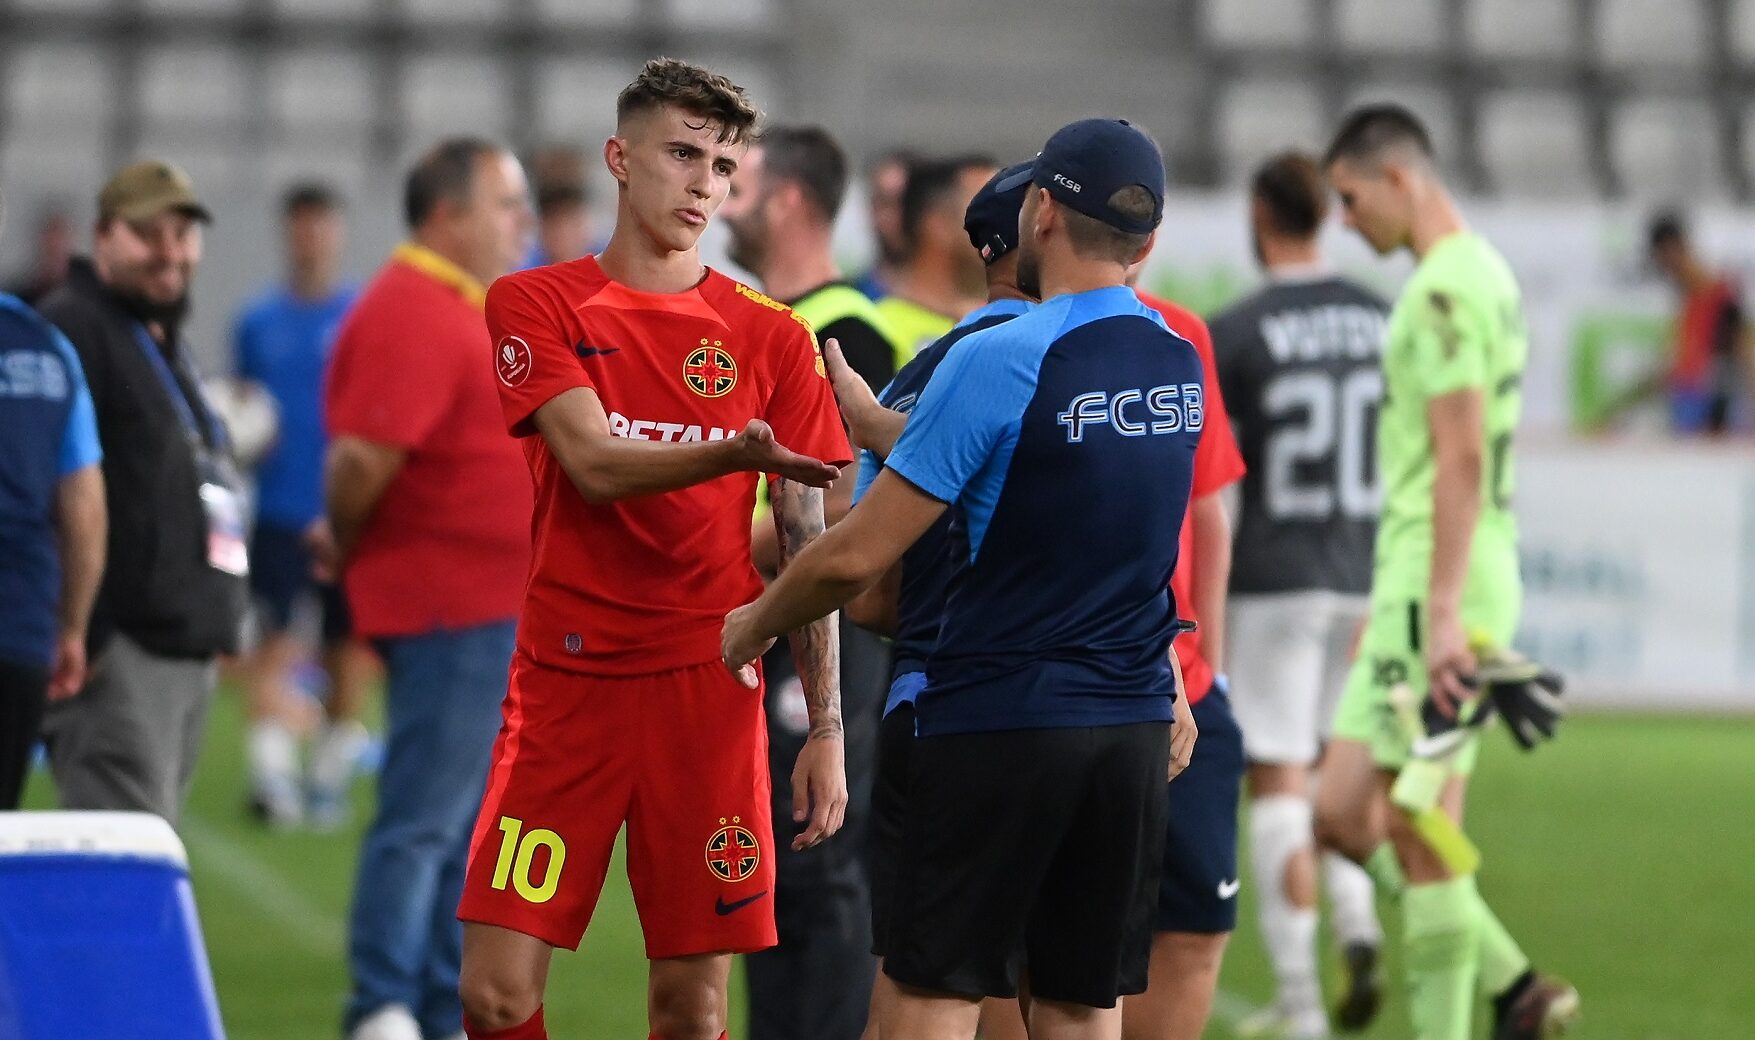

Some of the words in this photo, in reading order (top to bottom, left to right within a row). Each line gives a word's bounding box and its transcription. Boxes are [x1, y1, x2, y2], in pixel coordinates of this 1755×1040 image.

[1053, 173, 1082, 193] FCSB
[1057, 383, 1204, 443] FCSB
[491, 816, 566, 903] 10
